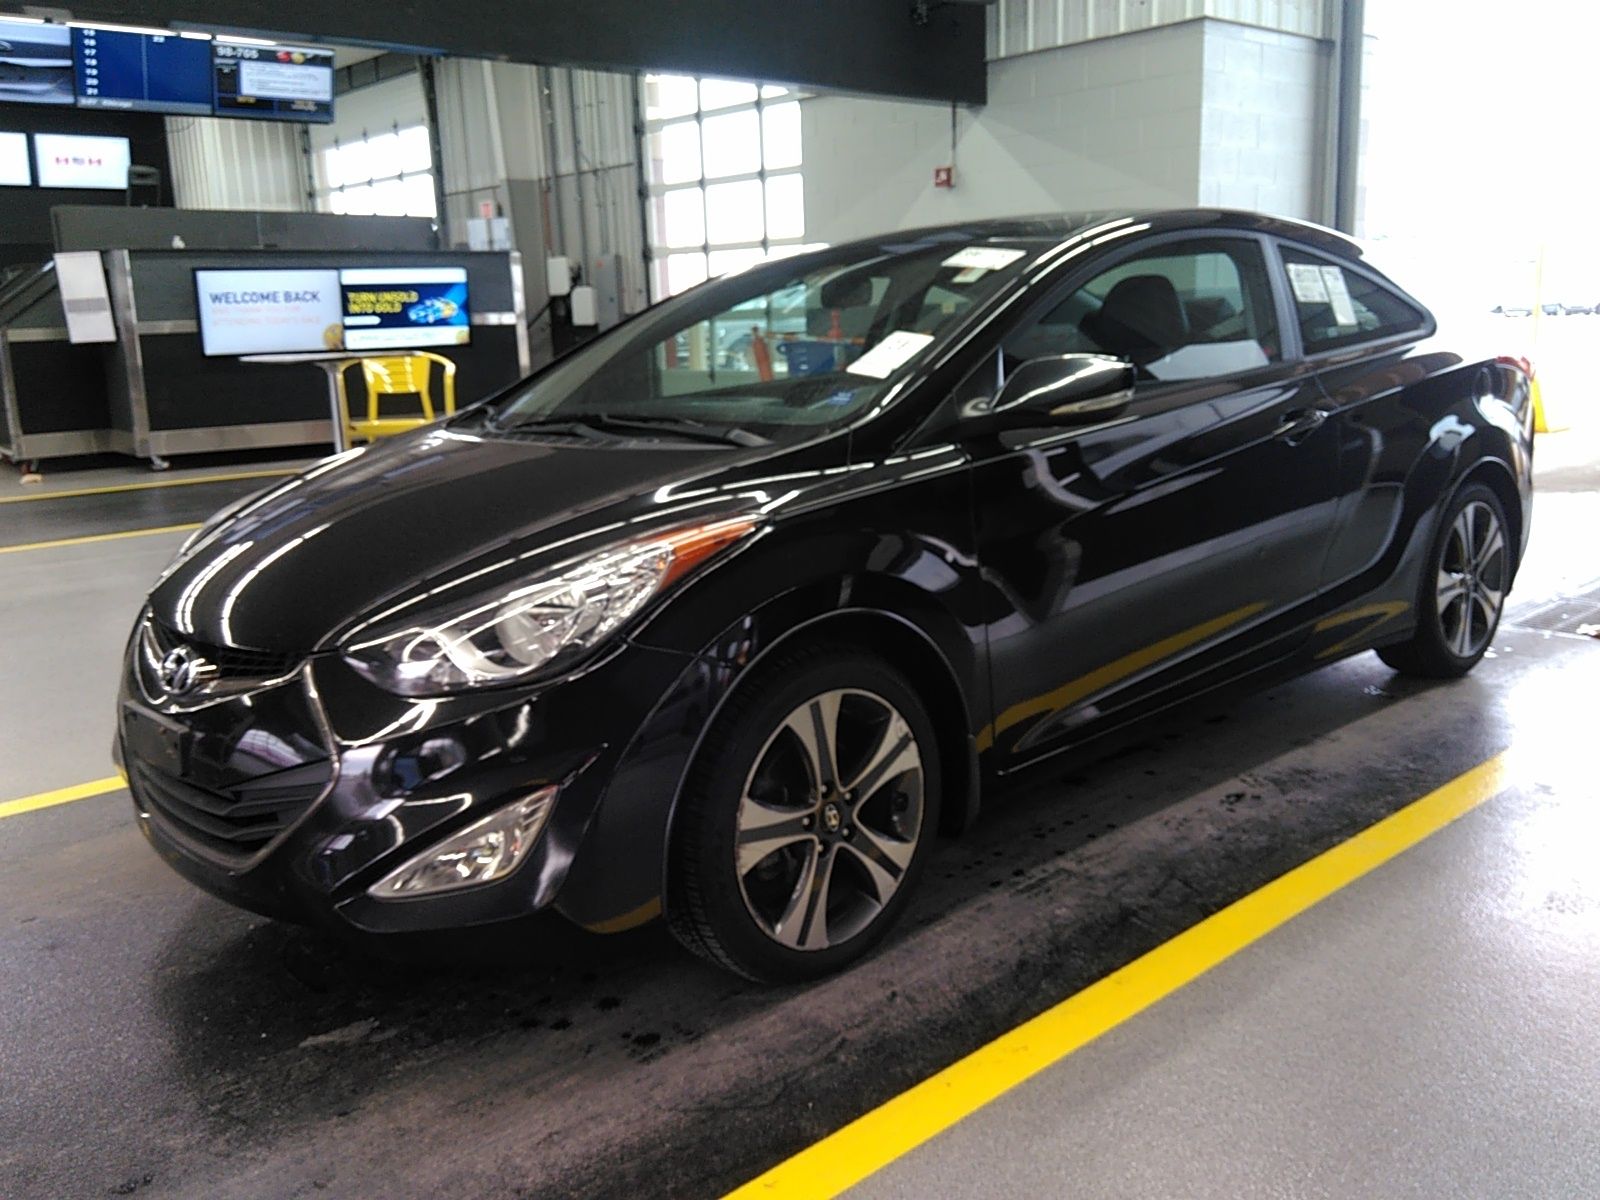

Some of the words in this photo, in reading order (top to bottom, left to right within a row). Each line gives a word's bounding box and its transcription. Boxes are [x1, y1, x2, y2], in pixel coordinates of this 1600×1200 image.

[209, 290, 281, 304] WELCOME
[284, 290, 321, 303] BACK
[348, 302, 374, 314] INTO
[374, 302, 402, 313] GOLD
